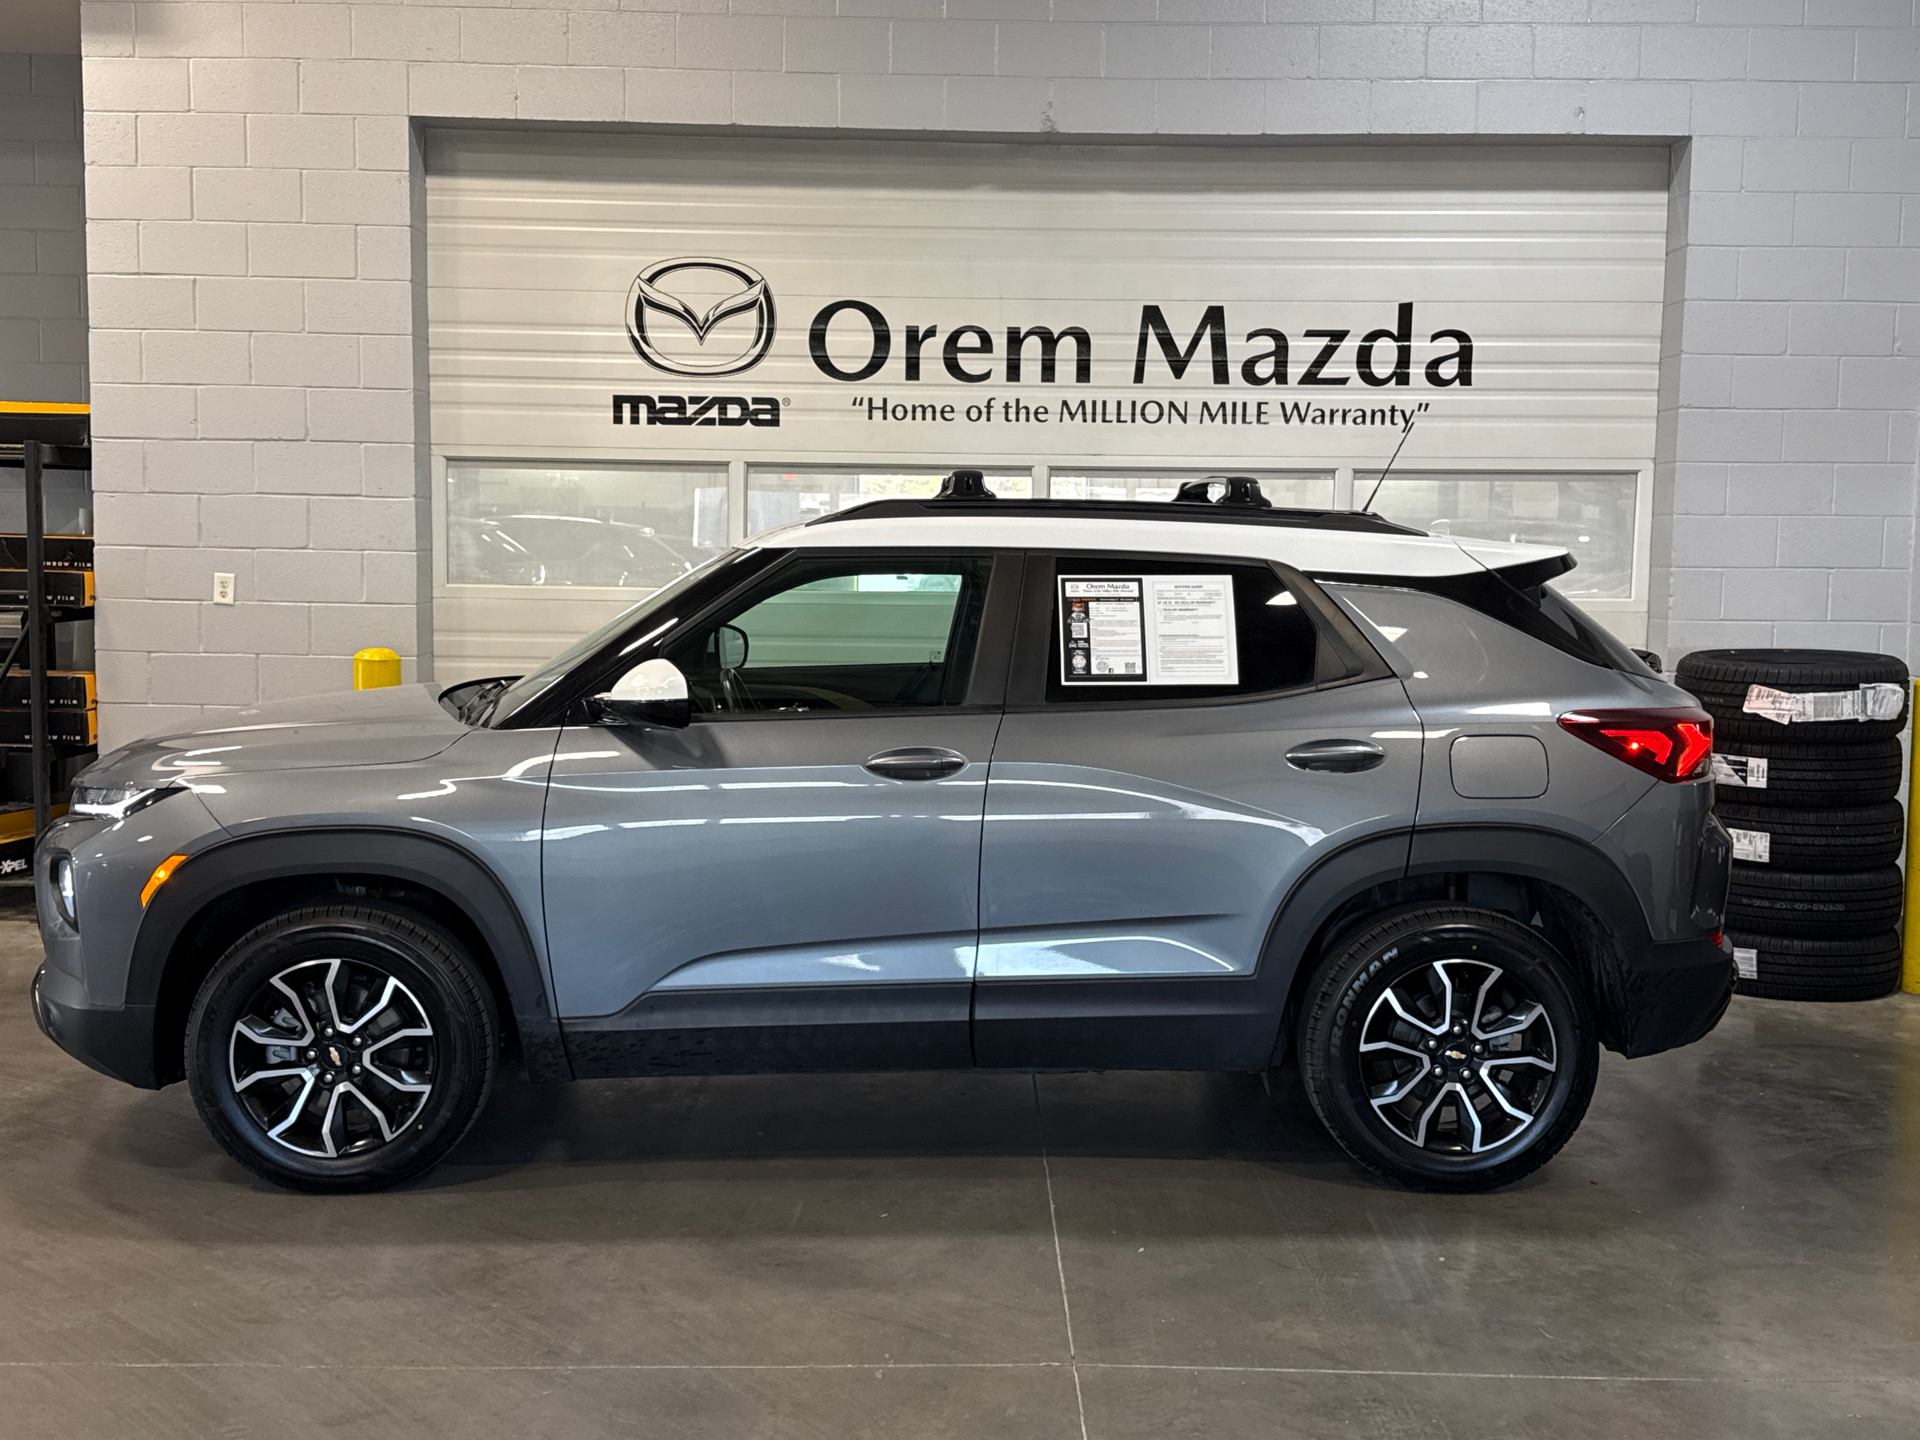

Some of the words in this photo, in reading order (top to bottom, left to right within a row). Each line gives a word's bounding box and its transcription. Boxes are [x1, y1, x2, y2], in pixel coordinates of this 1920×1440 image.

[809, 299, 1091, 384] Orem
[1133, 301, 1474, 388] Mazda
[965, 397, 996, 423] of
[1002, 398, 1050, 423] the
[1059, 399, 1188, 425] MILLION
[1199, 401, 1269, 425] MILE
[0, 858, 28, 875] XPEL
[1329, 946, 1399, 1057] IRONMAN
